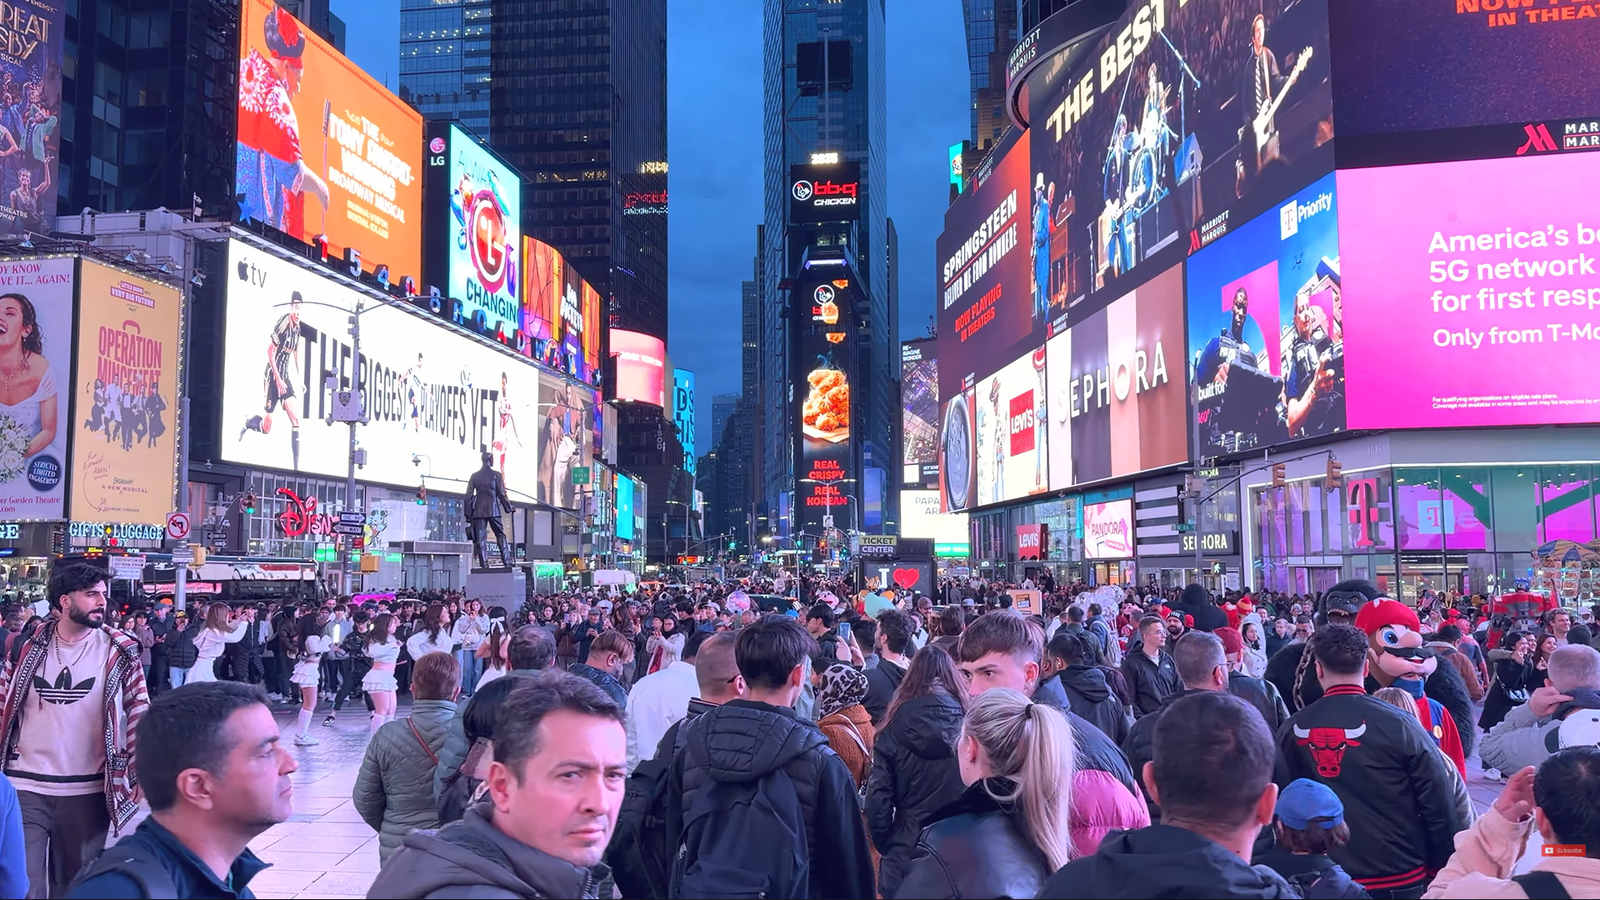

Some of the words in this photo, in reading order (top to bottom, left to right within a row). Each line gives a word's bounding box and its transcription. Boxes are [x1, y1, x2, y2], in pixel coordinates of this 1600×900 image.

[1488, 12, 1517, 28] IN
[1010, 28, 1040, 67] MARRIOTT
[1010, 46, 1036, 81] MARQUIS
[329, 112, 365, 157] TONY
[361, 116, 380, 143] THE
[1565, 122, 1600, 134] MAR
[1566, 135, 1600, 147] MAR
[431, 156, 445, 166] LG
[329, 166, 374, 206] BROADWAY
[375, 193, 405, 224] MUSICAL
[814, 197, 856, 206] CHICKEN
[1298, 192, 1332, 223] Priority
[1202, 209, 1230, 234] MARRIOTT
[943, 188, 1018, 284] SPRINGSTEEN
[1202, 223, 1227, 244] MARQUIS
[12, 264, 42, 274] KNOW
[250, 262, 267, 288] tv
[944, 276, 963, 310] DELIVER
[972, 251, 988, 283] FROM
[988, 222, 1018, 269] NOWHERE
[1429, 259, 1469, 283] 5G
[1477, 253, 1596, 280] network
[36, 274, 70, 285] AGAIN!
[467, 277, 519, 324] CHANGIN
[955, 308, 971, 333] NOW
[971, 282, 1002, 320] PLAYING
[1431, 290, 1471, 312] for
[1476, 287, 1535, 311] first
[967, 306, 996, 337] THEATERS
[98, 325, 162, 369] OPERATION
[1433, 328, 1484, 350] Only
[1489, 326, 1543, 344] from
[300, 320, 351, 419] THE
[358, 352, 408, 421] BIGGEST
[420, 383, 467, 445] PLAYOFFS
[471, 387, 499, 454] YET
[1057, 341, 1169, 422] SEPHORA
[1198, 382, 1215, 401] built
[1214, 380, 1226, 395] for
[33, 461, 59, 472] STRICTLY
[33, 469, 56, 478] LIMITED
[808, 471, 845, 480] CRISPY
[814, 461, 839, 469] REAL
[28, 474, 58, 484] ENGAGEMENT
[9, 496, 33, 504] Garden
[36, 496, 60, 504] Theatre
[815, 486, 840, 495] REAL
[807, 497, 847, 506] KOREAN
[69, 522, 105, 538] GIFTS
[113, 524, 164, 540] LUGGAGE
[1092, 521, 1123, 537] PANDORA
[862, 537, 893, 545] TICKET
